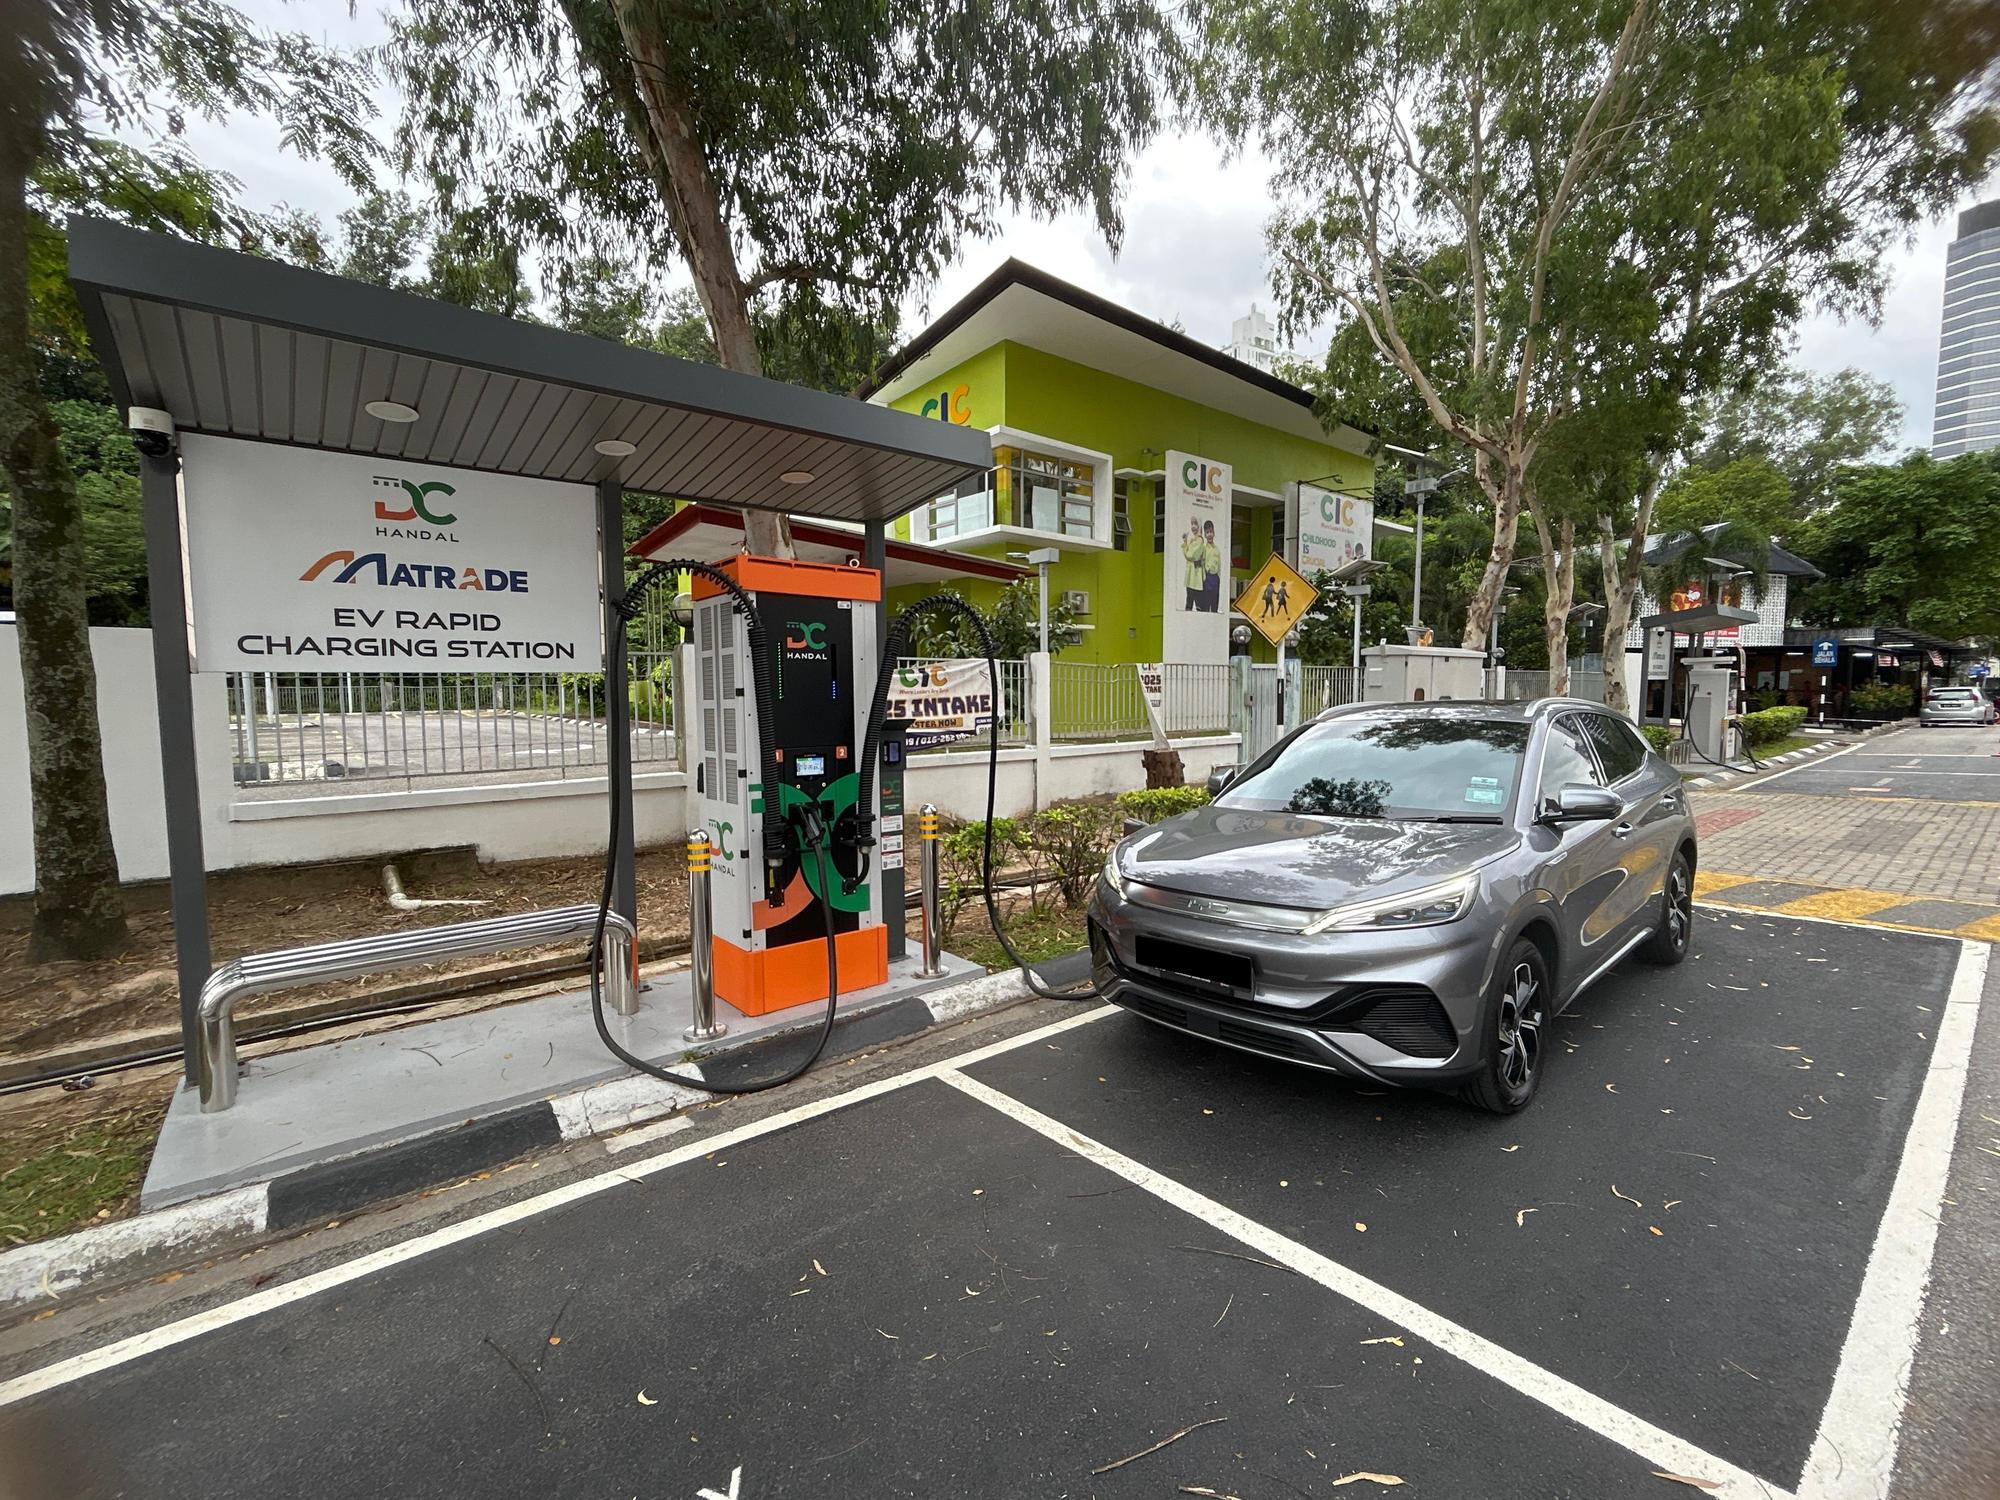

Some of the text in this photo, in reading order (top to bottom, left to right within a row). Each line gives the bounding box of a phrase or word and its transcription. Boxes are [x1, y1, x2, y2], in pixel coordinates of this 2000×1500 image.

[1182, 461, 1223, 494] CIC
[1320, 494, 1354, 527] CIC
[376, 527, 459, 543] HANDAL
[1301, 533, 1336, 548] CHILDHOOD
[1302, 543, 1310, 554] IS
[298, 550, 529, 593] MATRADE
[334, 608, 501, 631] EV RAPID
[237, 635, 575, 660] CHARGING STATION
[786, 652, 828, 660] HANDAL
[887, 695, 991, 717] 25 INTAKE
[912, 719, 957, 729] STER NOW
